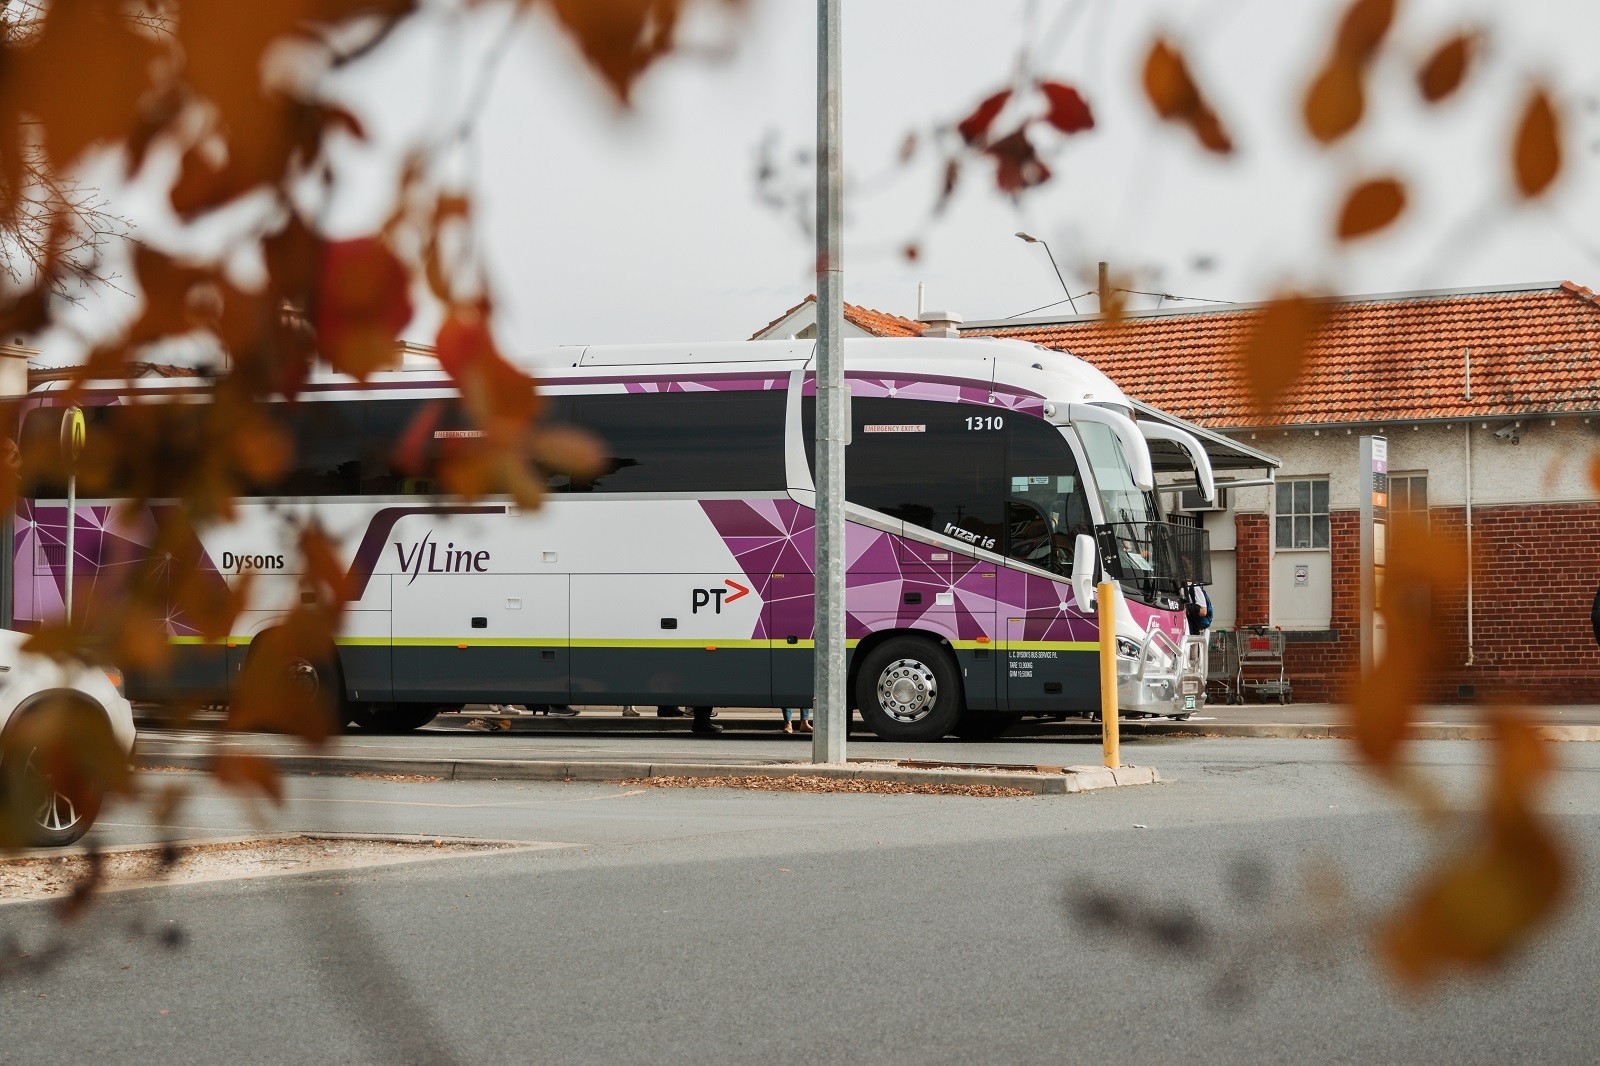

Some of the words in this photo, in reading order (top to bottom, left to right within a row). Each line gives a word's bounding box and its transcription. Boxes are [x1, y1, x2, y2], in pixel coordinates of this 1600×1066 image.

[965, 416, 1004, 431] 1310
[943, 522, 981, 543] Irizar
[980, 535, 996, 549] i6
[222, 551, 285, 573] Dysons
[393, 529, 491, 587] V/Line
